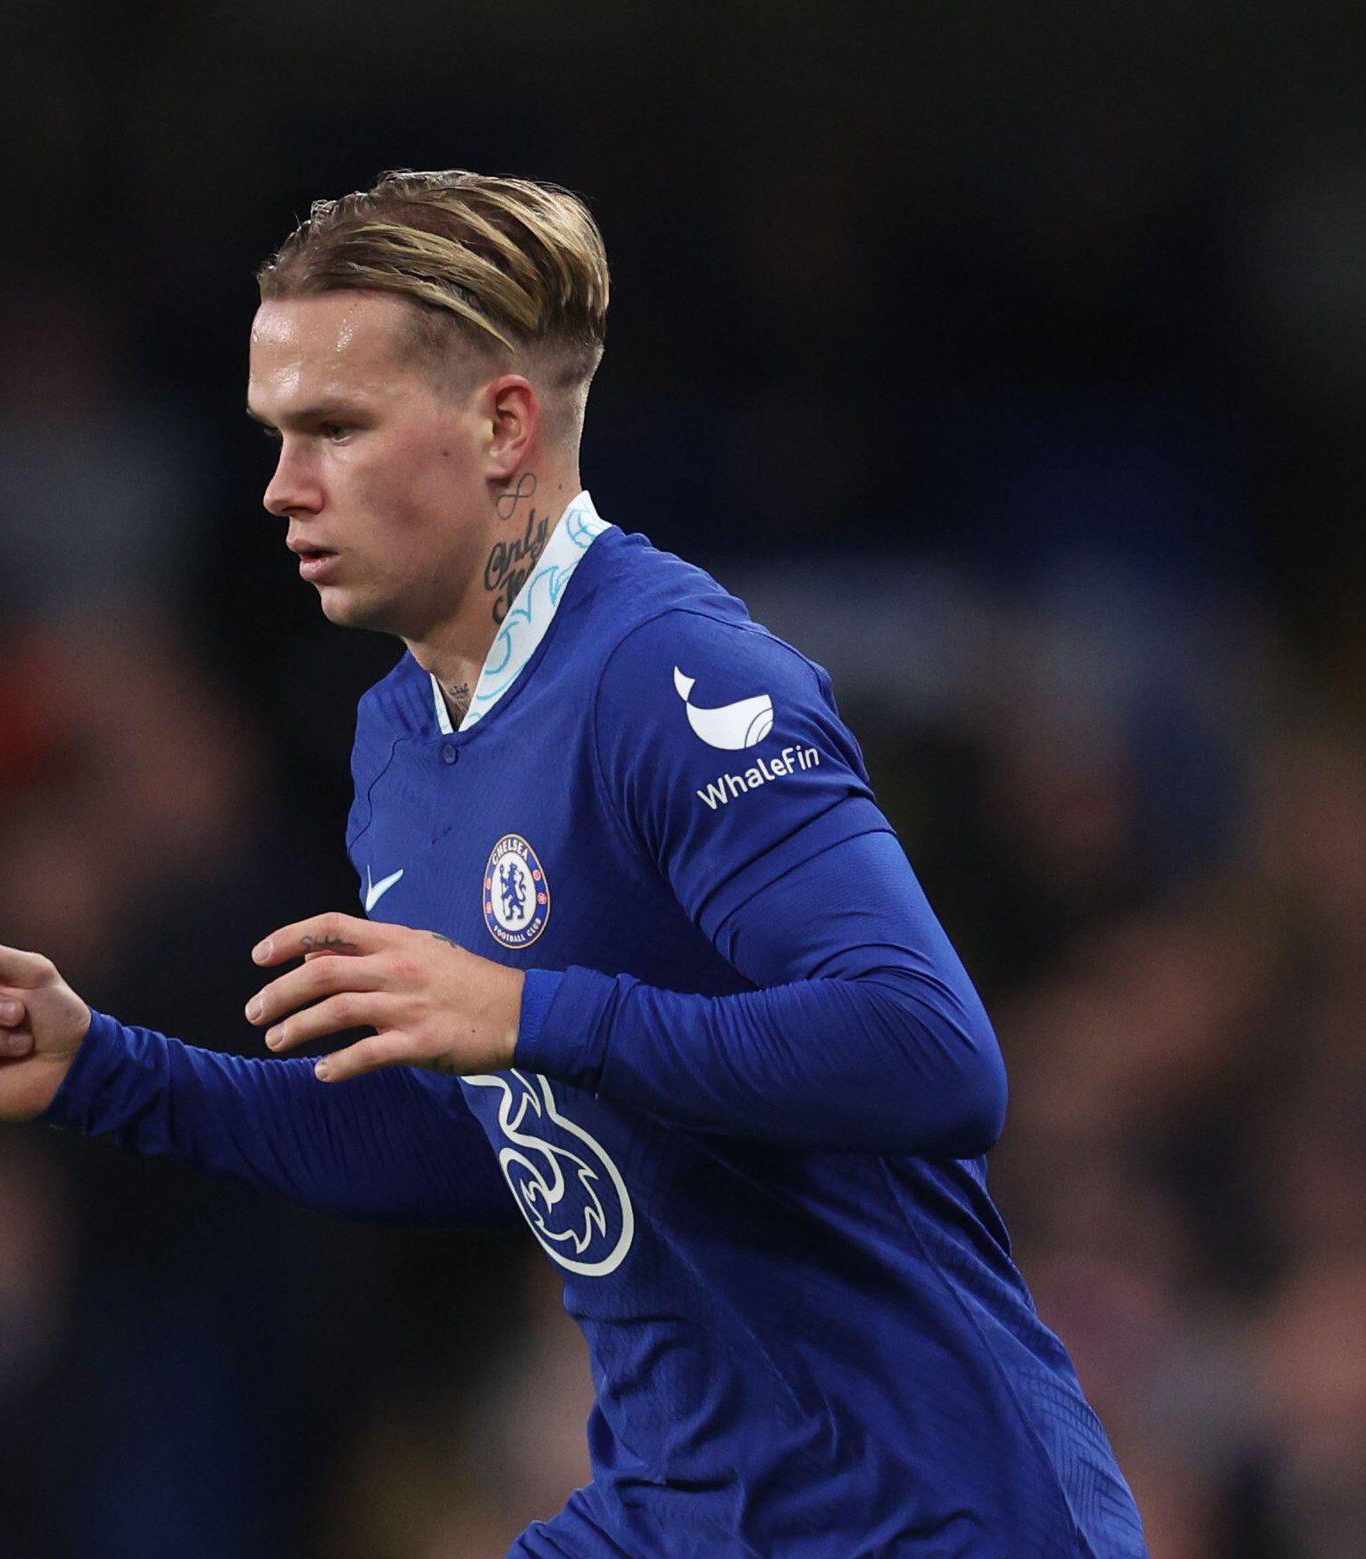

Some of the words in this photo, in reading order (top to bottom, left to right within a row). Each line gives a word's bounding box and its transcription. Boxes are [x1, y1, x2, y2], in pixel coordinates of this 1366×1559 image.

[696, 744, 820, 810] WhaleFin
[492, 838, 528, 865] CHELSEA
[493, 925, 526, 942] FOOTBALL
[527, 917, 542, 937] CLUB
